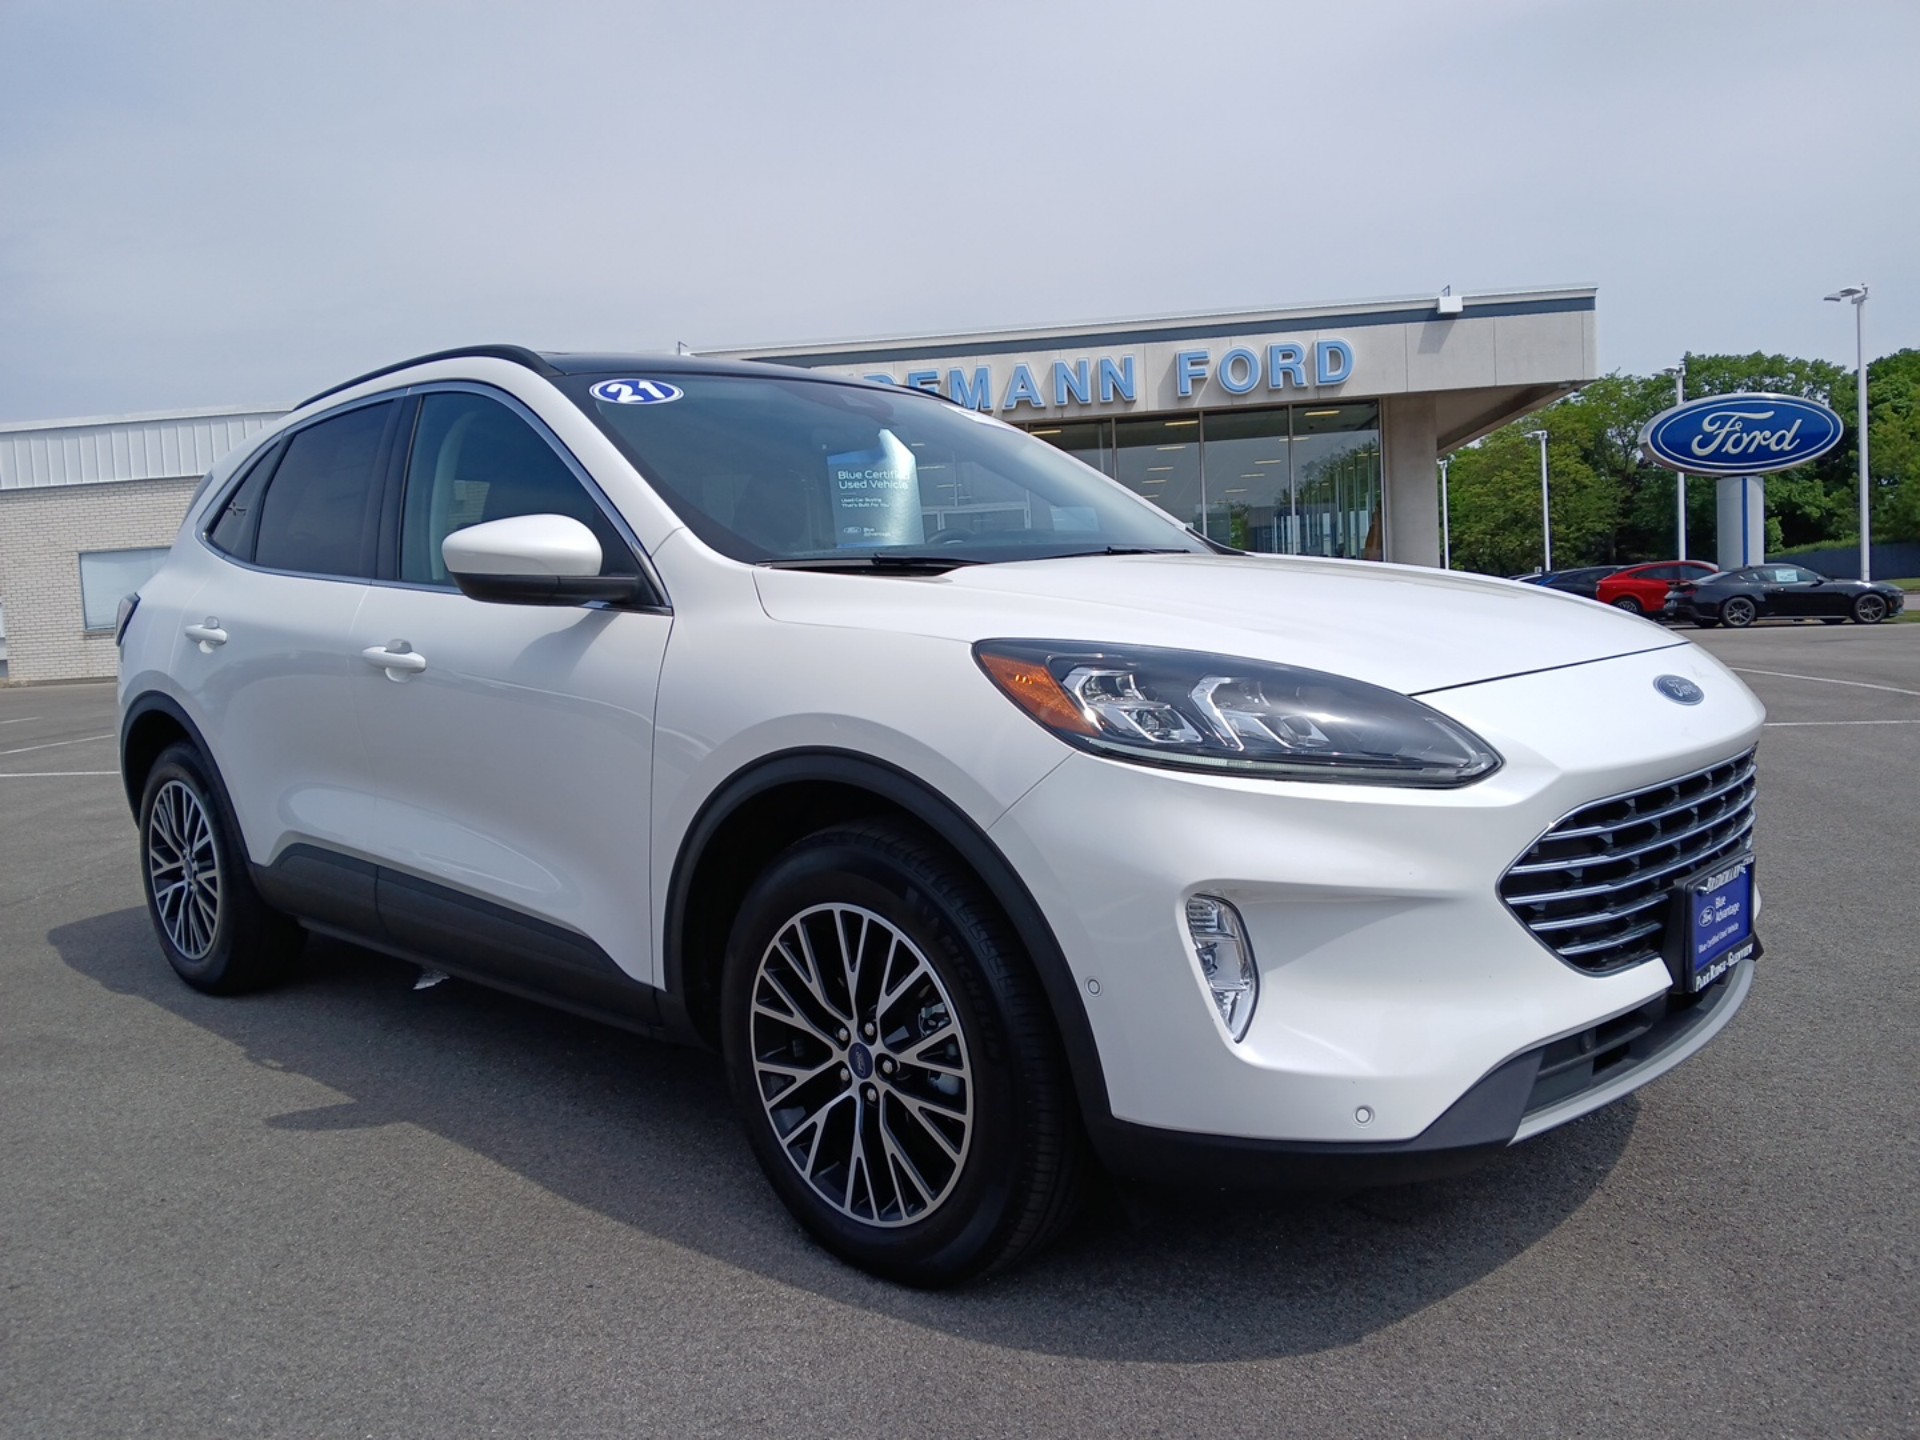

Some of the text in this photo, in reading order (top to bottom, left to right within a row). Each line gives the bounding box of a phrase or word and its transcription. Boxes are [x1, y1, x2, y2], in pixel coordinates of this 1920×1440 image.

[1176, 338, 1356, 399] FORD
[605, 380, 666, 403] 21
[1691, 410, 1803, 457] Ford
[838, 469, 910, 480] Blue Certifid
[838, 479, 909, 490] Used Vehicle
